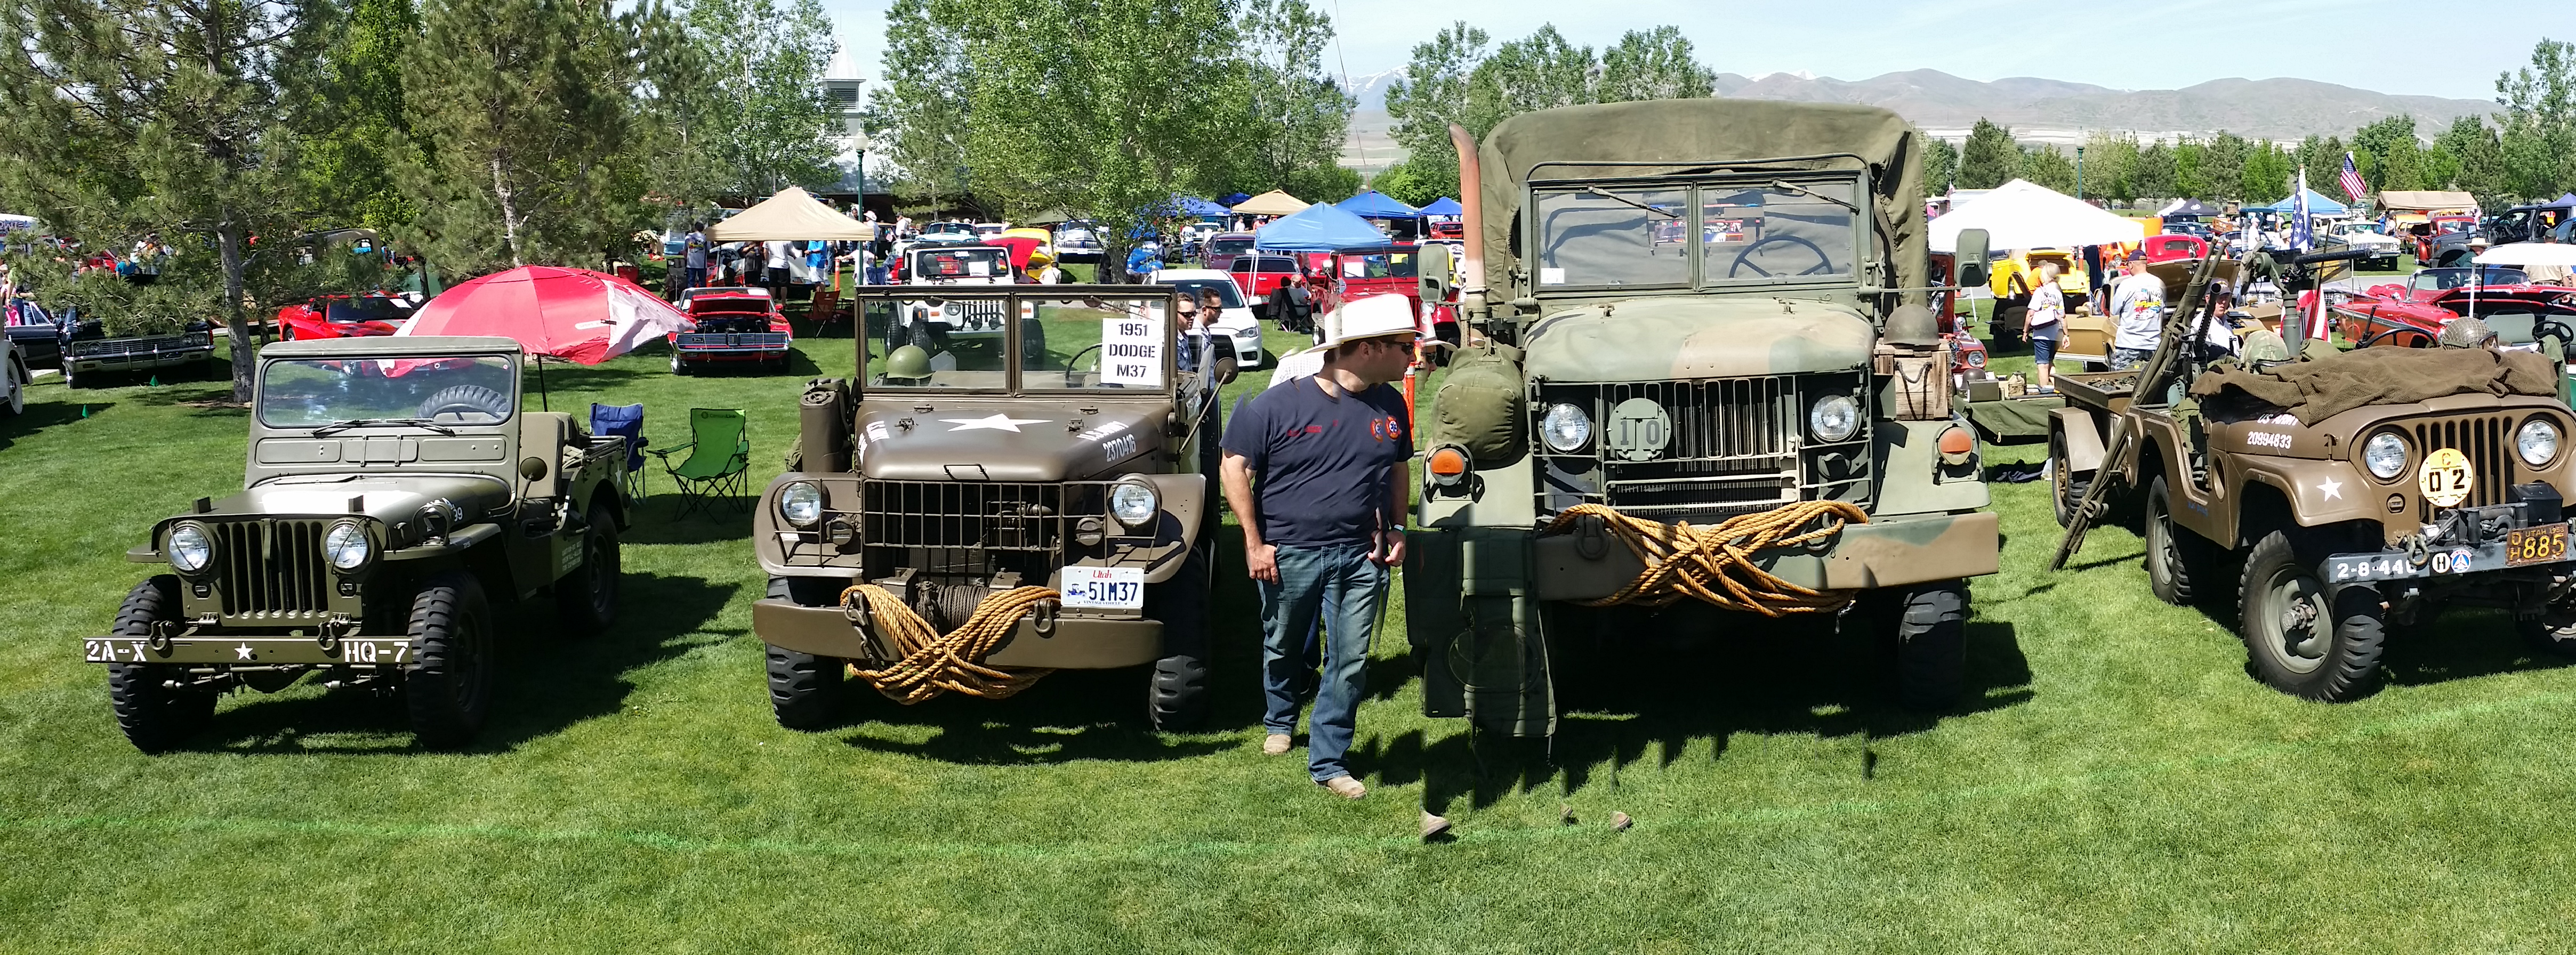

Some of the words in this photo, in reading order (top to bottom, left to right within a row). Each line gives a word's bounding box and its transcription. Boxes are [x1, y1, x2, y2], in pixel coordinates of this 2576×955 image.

[1118, 323, 1147, 336] 1951
[1109, 344, 1155, 358] DODGE
[1117, 364, 1147, 377] M37
[1102, 434, 1136, 462] 2370416
[2247, 431, 2292, 449] 20994833
[2523, 533, 2565, 559] 885
[2437, 556, 2446, 570] H
[1093, 570, 1112, 579] Utah
[1089, 581, 1138, 601] 51M37
[86, 641, 147, 661] 2A-X
[344, 641, 409, 662] HQ-7
